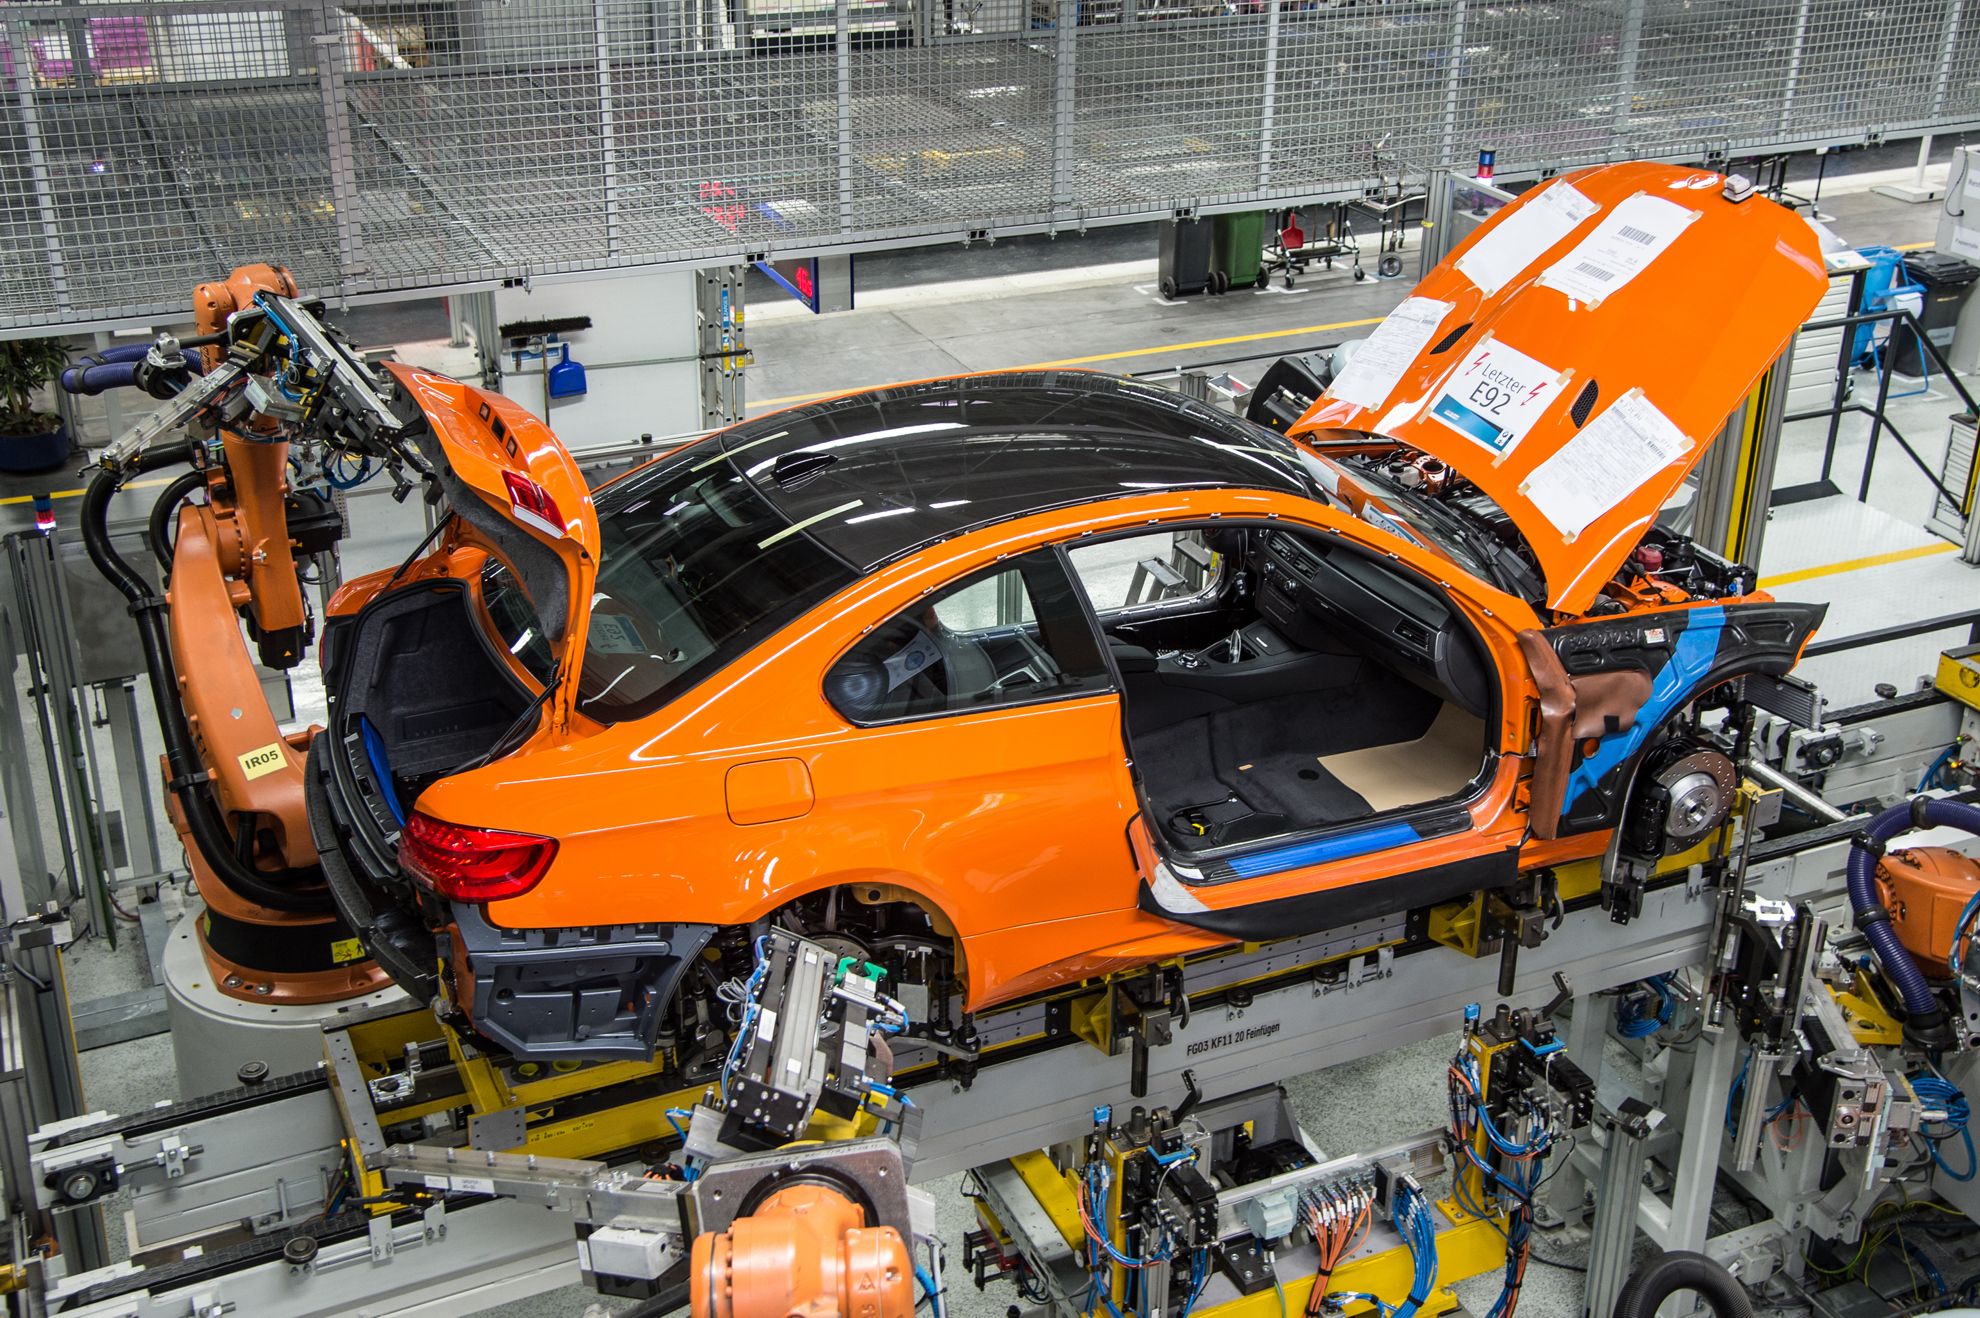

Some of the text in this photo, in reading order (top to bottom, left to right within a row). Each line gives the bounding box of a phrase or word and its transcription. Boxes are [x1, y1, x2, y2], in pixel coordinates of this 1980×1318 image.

[1482, 363, 1526, 394] Letzter
[1469, 380, 1511, 416] E92
[245, 750, 279, 769] IR05
[1186, 1023, 1280, 1056] FG03 KF11 20 Feinfügen
